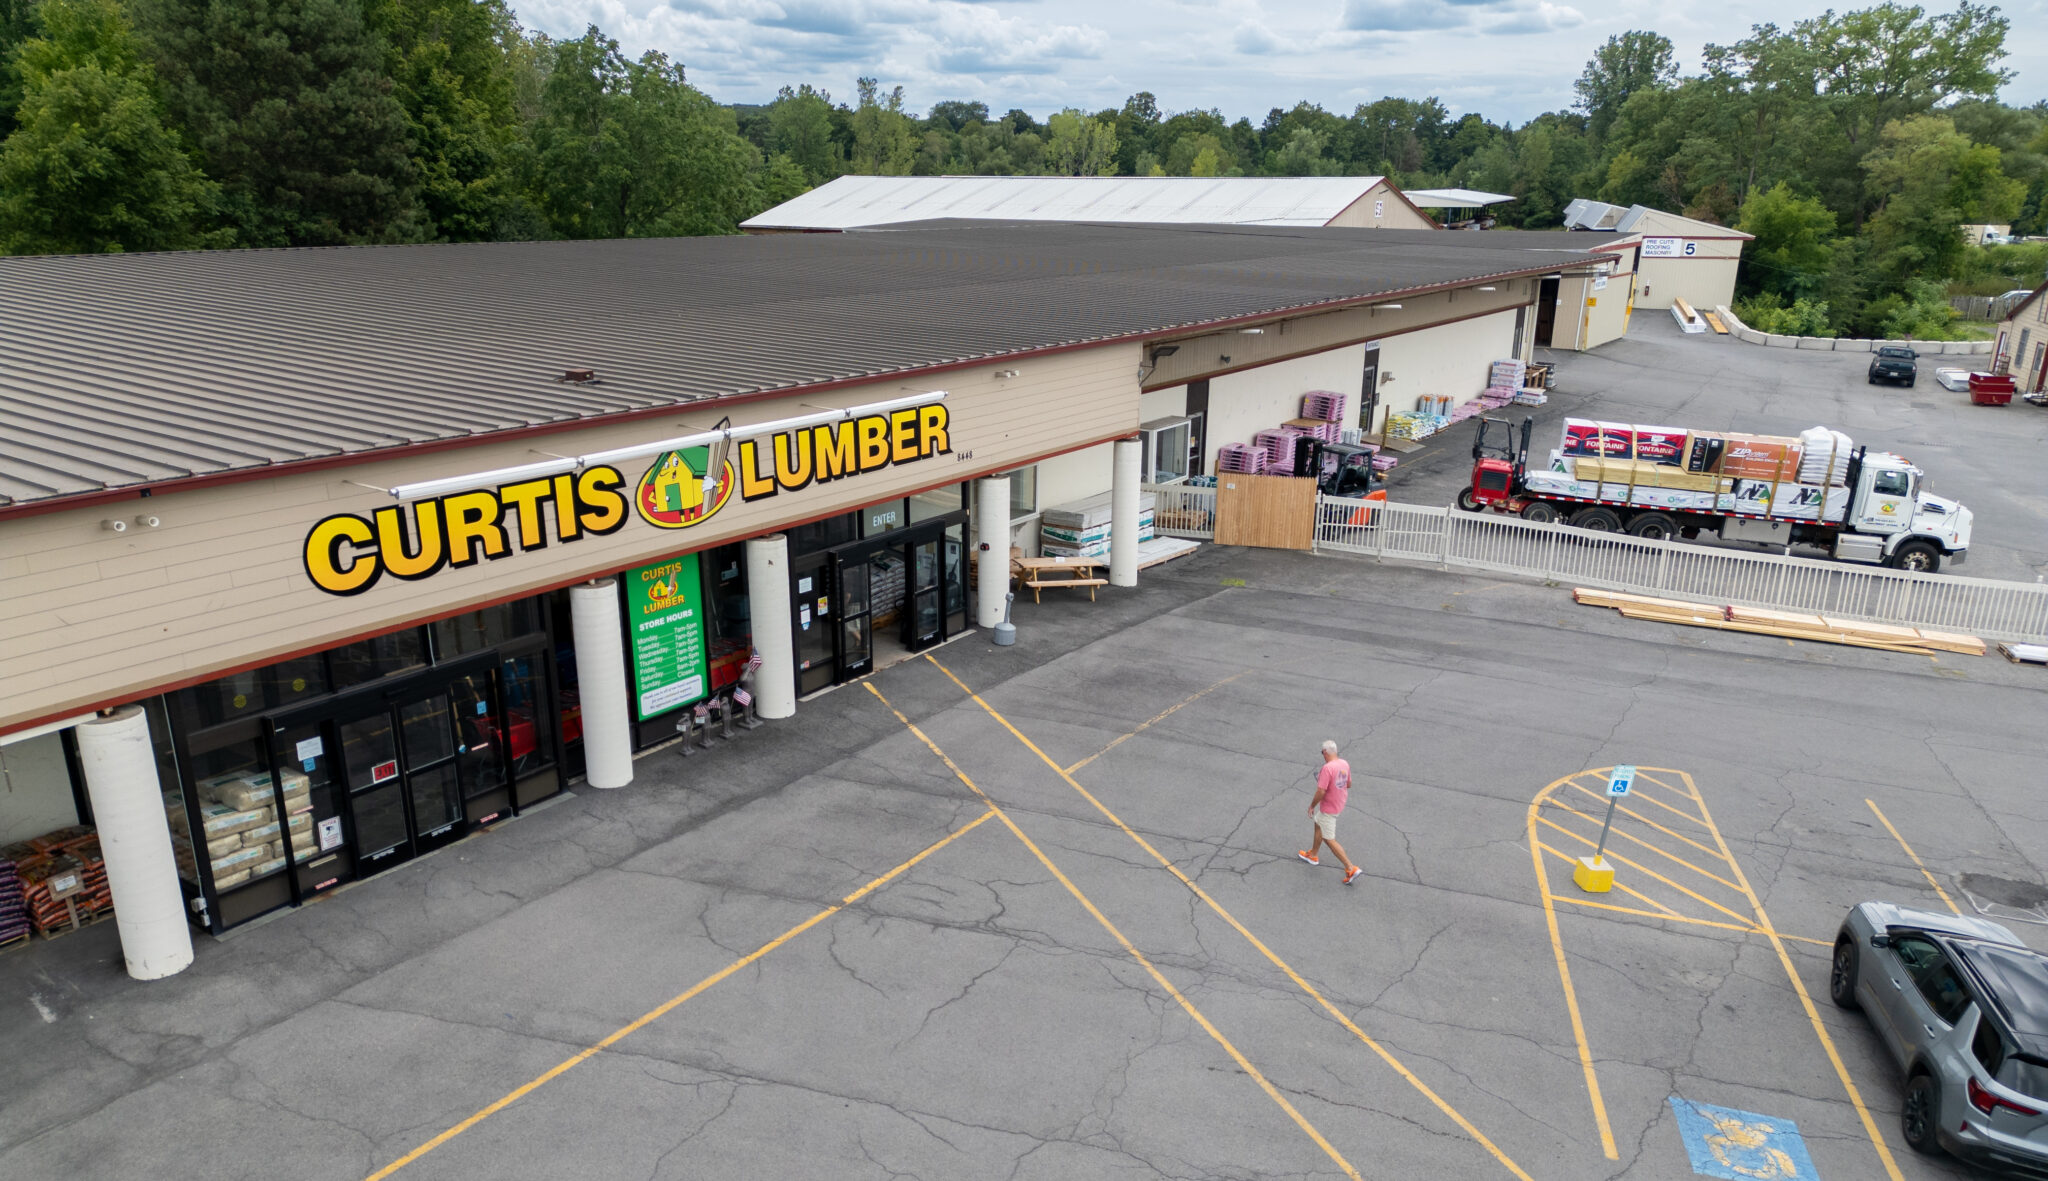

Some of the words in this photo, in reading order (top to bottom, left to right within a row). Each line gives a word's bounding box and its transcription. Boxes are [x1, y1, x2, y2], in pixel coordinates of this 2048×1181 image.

[1685, 243, 1696, 255] 5
[1637, 445, 1674, 454] ONTAINE
[303, 464, 629, 597] CURTIS
[738, 403, 953, 502] LUMBER
[872, 511, 895, 527] ENTER
[641, 562, 682, 581] CURTIS
[644, 595, 685, 614] LUMBER
[639, 617, 665, 631] STORE
[666, 609, 693, 623] HOURS
[637, 635, 658, 645] Monday
[638, 642, 660, 652] Tuesday
[638, 647, 668, 660] Wednesday
[639, 656, 663, 667] Thursday
[640, 666, 656, 675] Friday
[640, 671, 663, 683] Saturday
[641, 680, 661, 690] Sunday
[374, 762, 396, 781] EXIT
